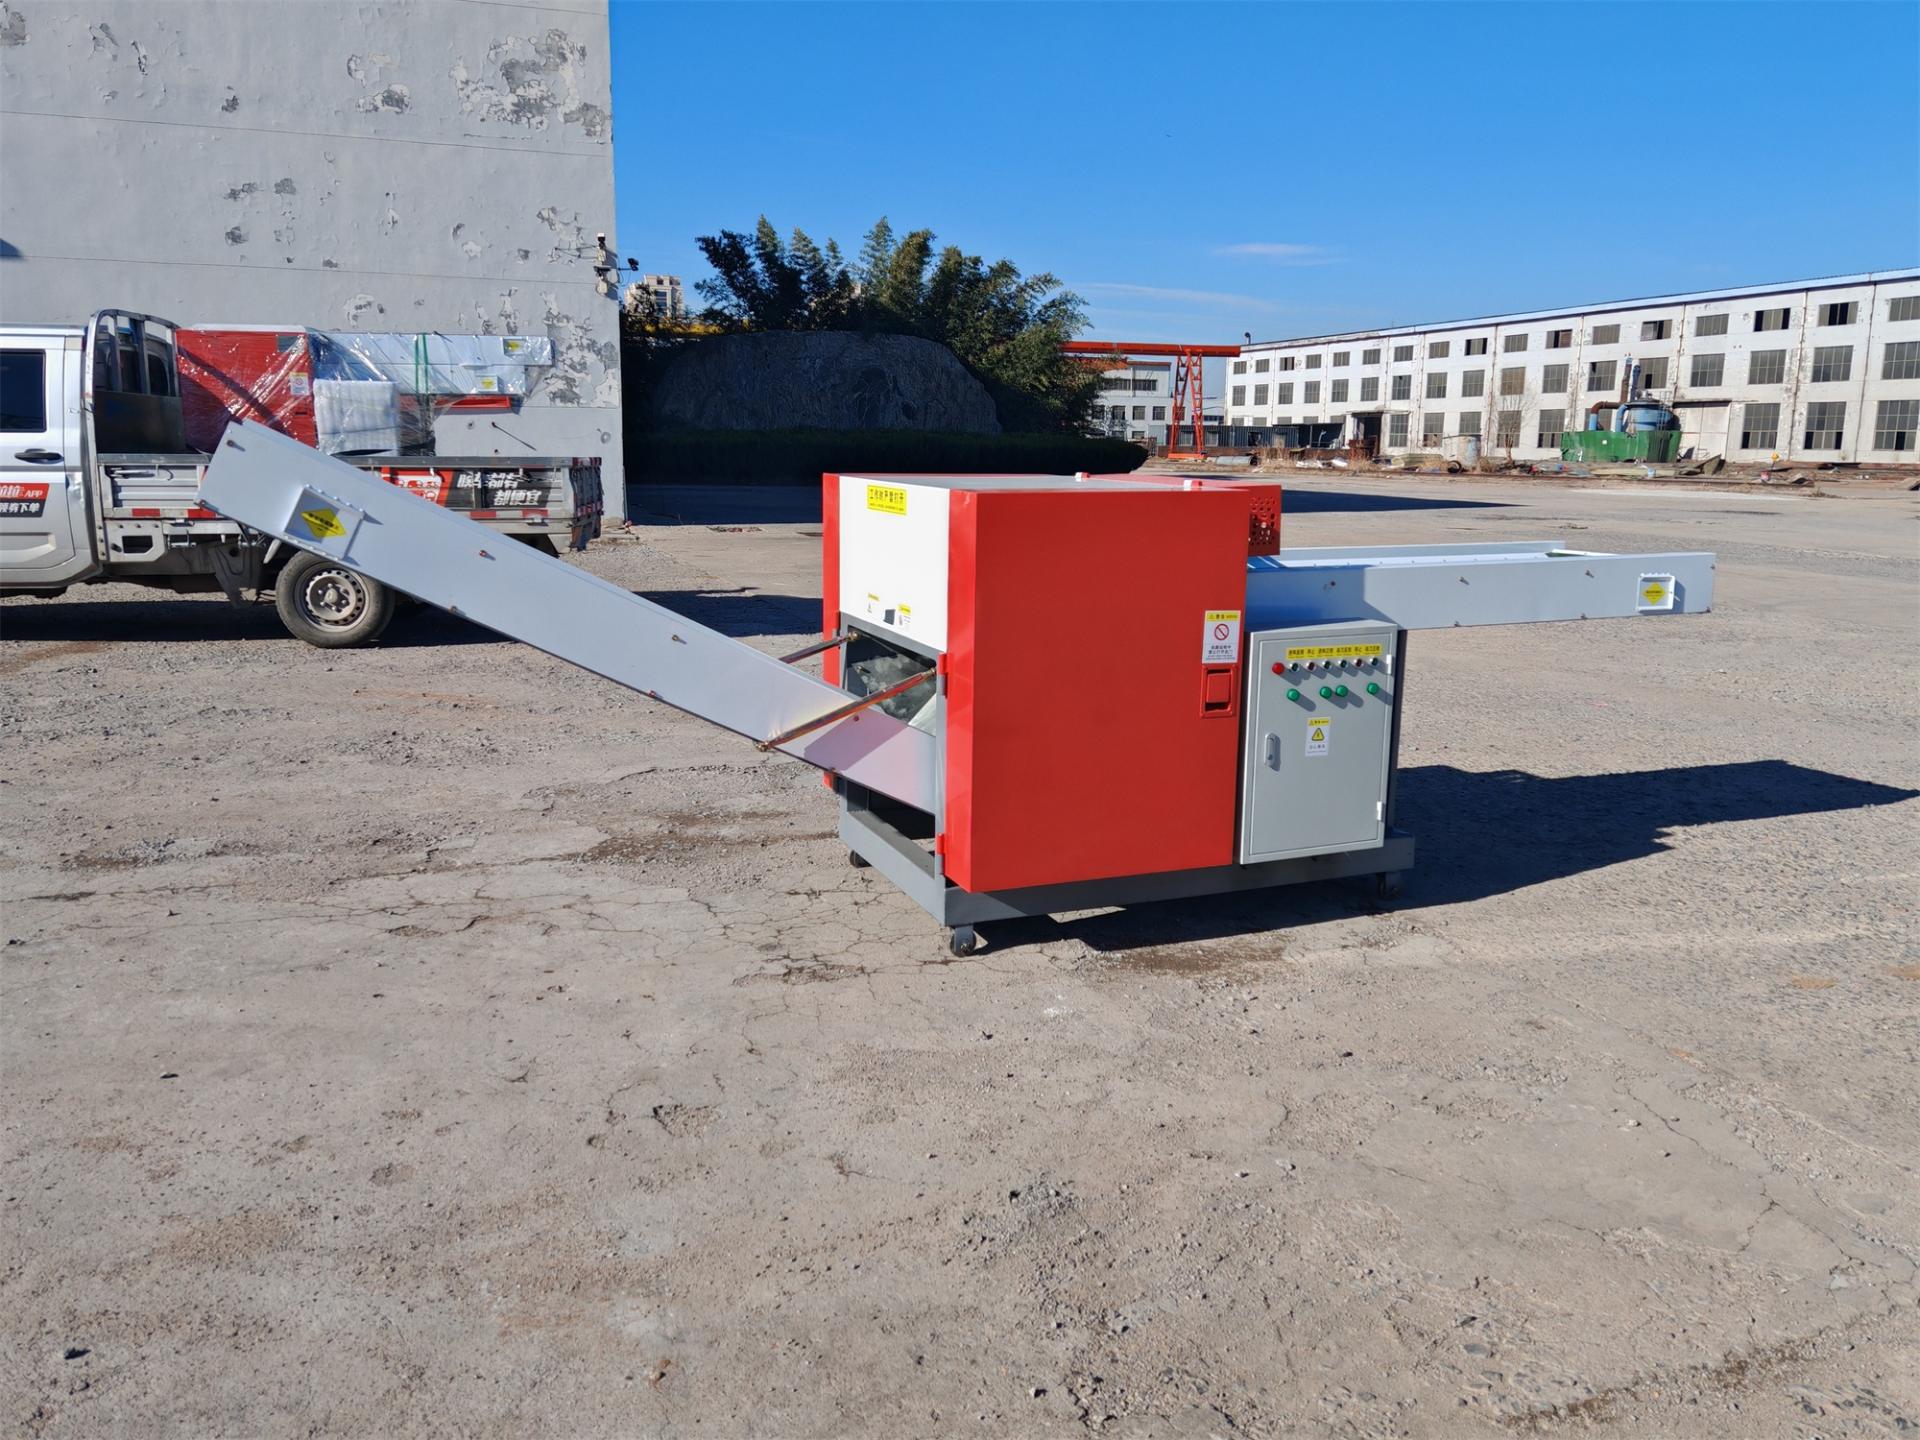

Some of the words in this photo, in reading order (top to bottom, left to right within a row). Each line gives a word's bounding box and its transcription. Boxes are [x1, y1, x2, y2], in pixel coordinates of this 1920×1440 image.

[24, 490, 43, 498] APP
[494, 489, 541, 506] 都便宜
